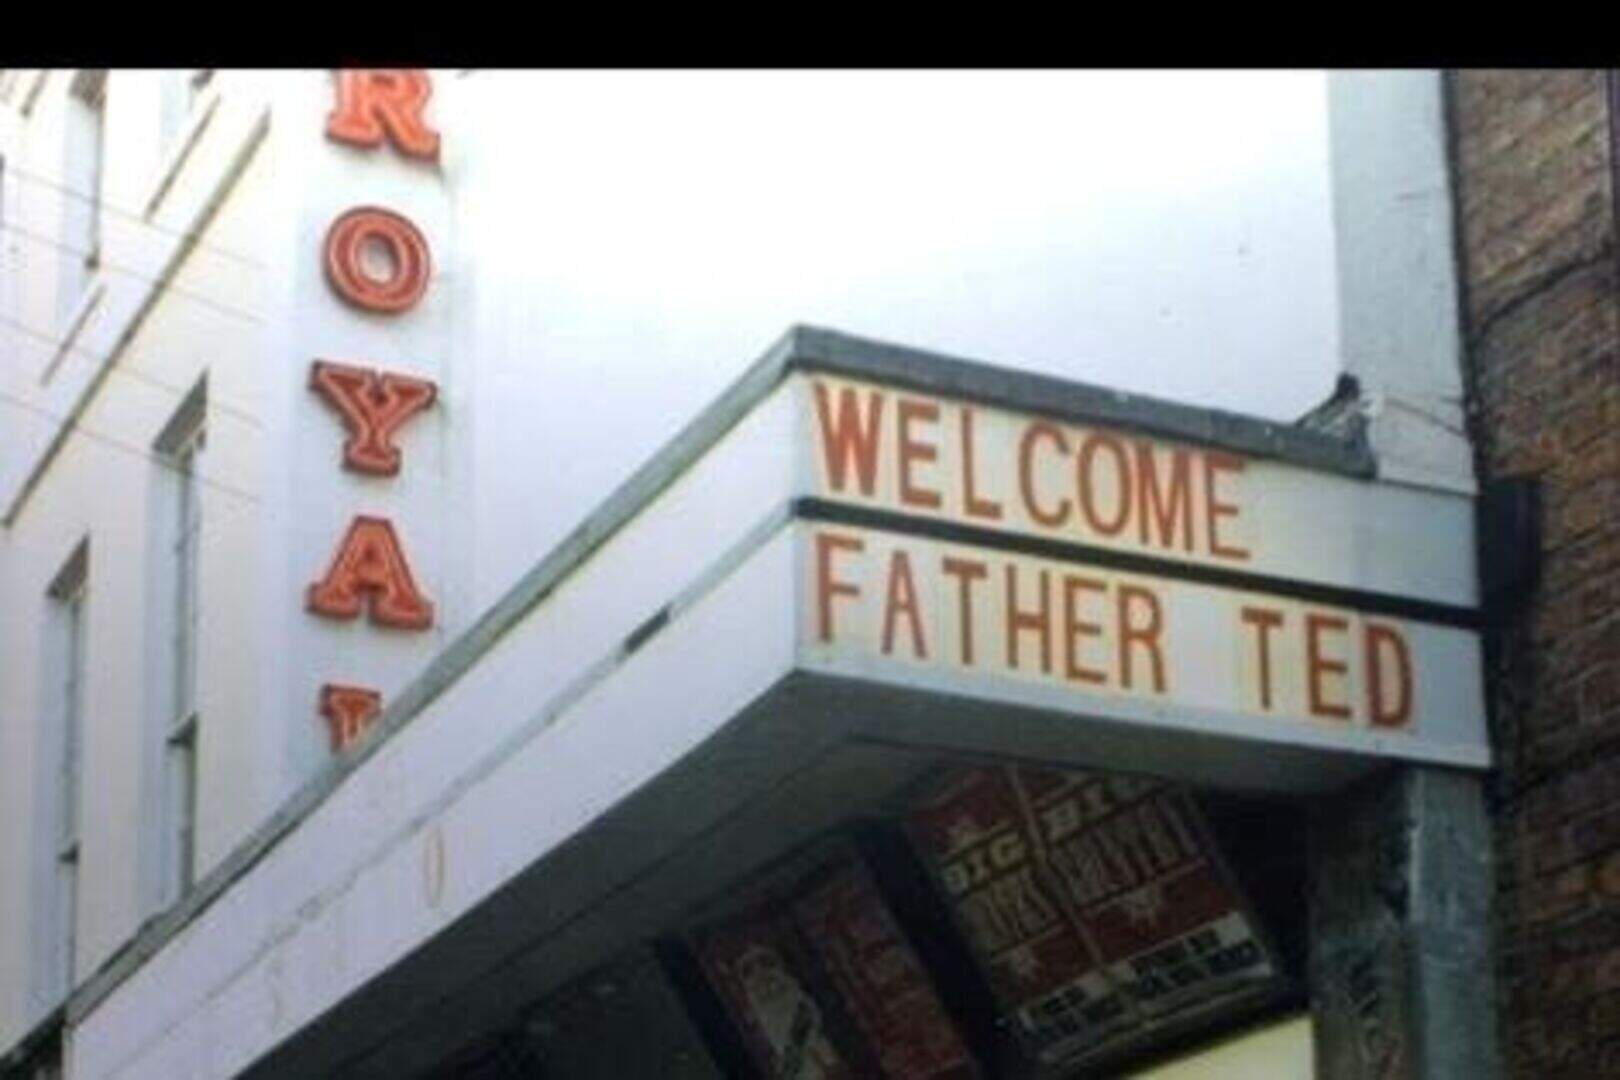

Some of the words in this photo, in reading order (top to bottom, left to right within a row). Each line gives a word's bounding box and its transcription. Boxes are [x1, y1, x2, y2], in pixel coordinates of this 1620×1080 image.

[815, 377, 1251, 560] WELCOME
[814, 531, 1167, 694] FATHER
[1241, 605, 1414, 730] TED
